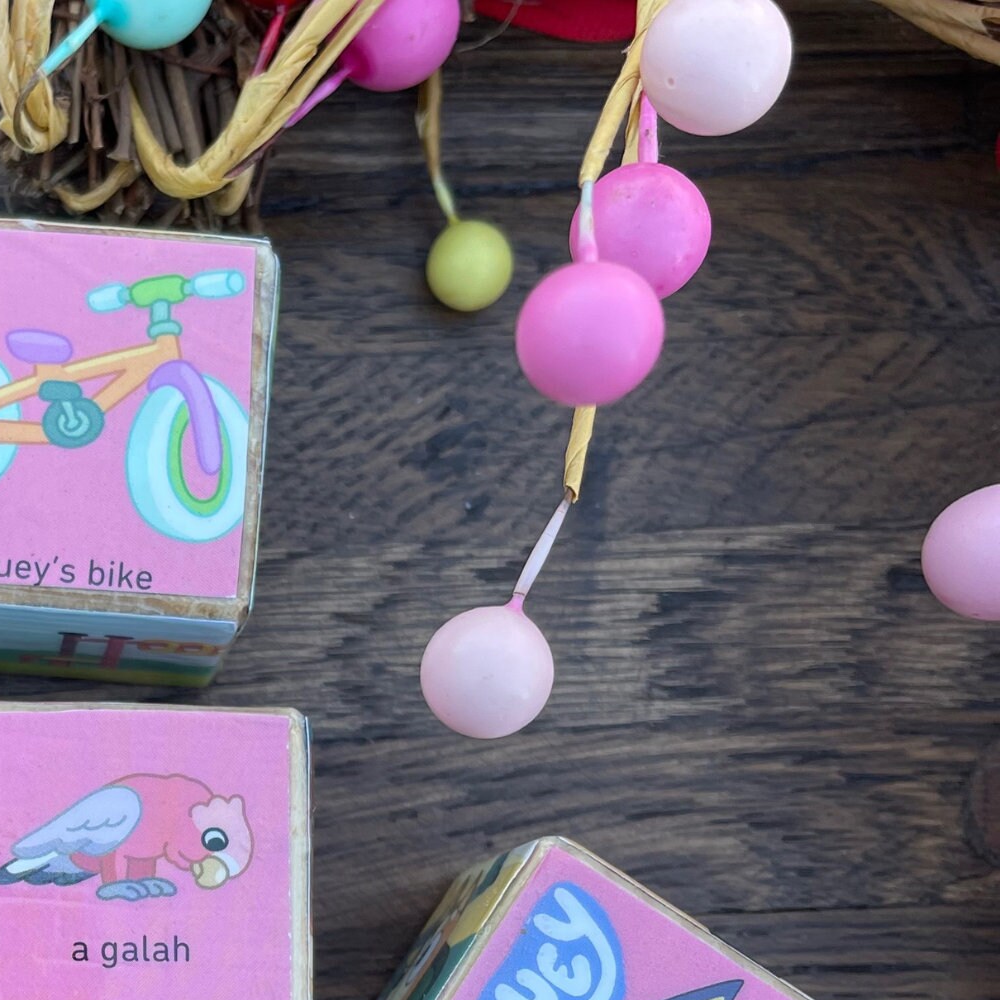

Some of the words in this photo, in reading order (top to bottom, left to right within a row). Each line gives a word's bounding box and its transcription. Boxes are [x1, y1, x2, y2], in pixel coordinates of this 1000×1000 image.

[88, 559, 153, 590] bike
[71, 941, 89, 962] a
[100, 934, 190, 969] galah
